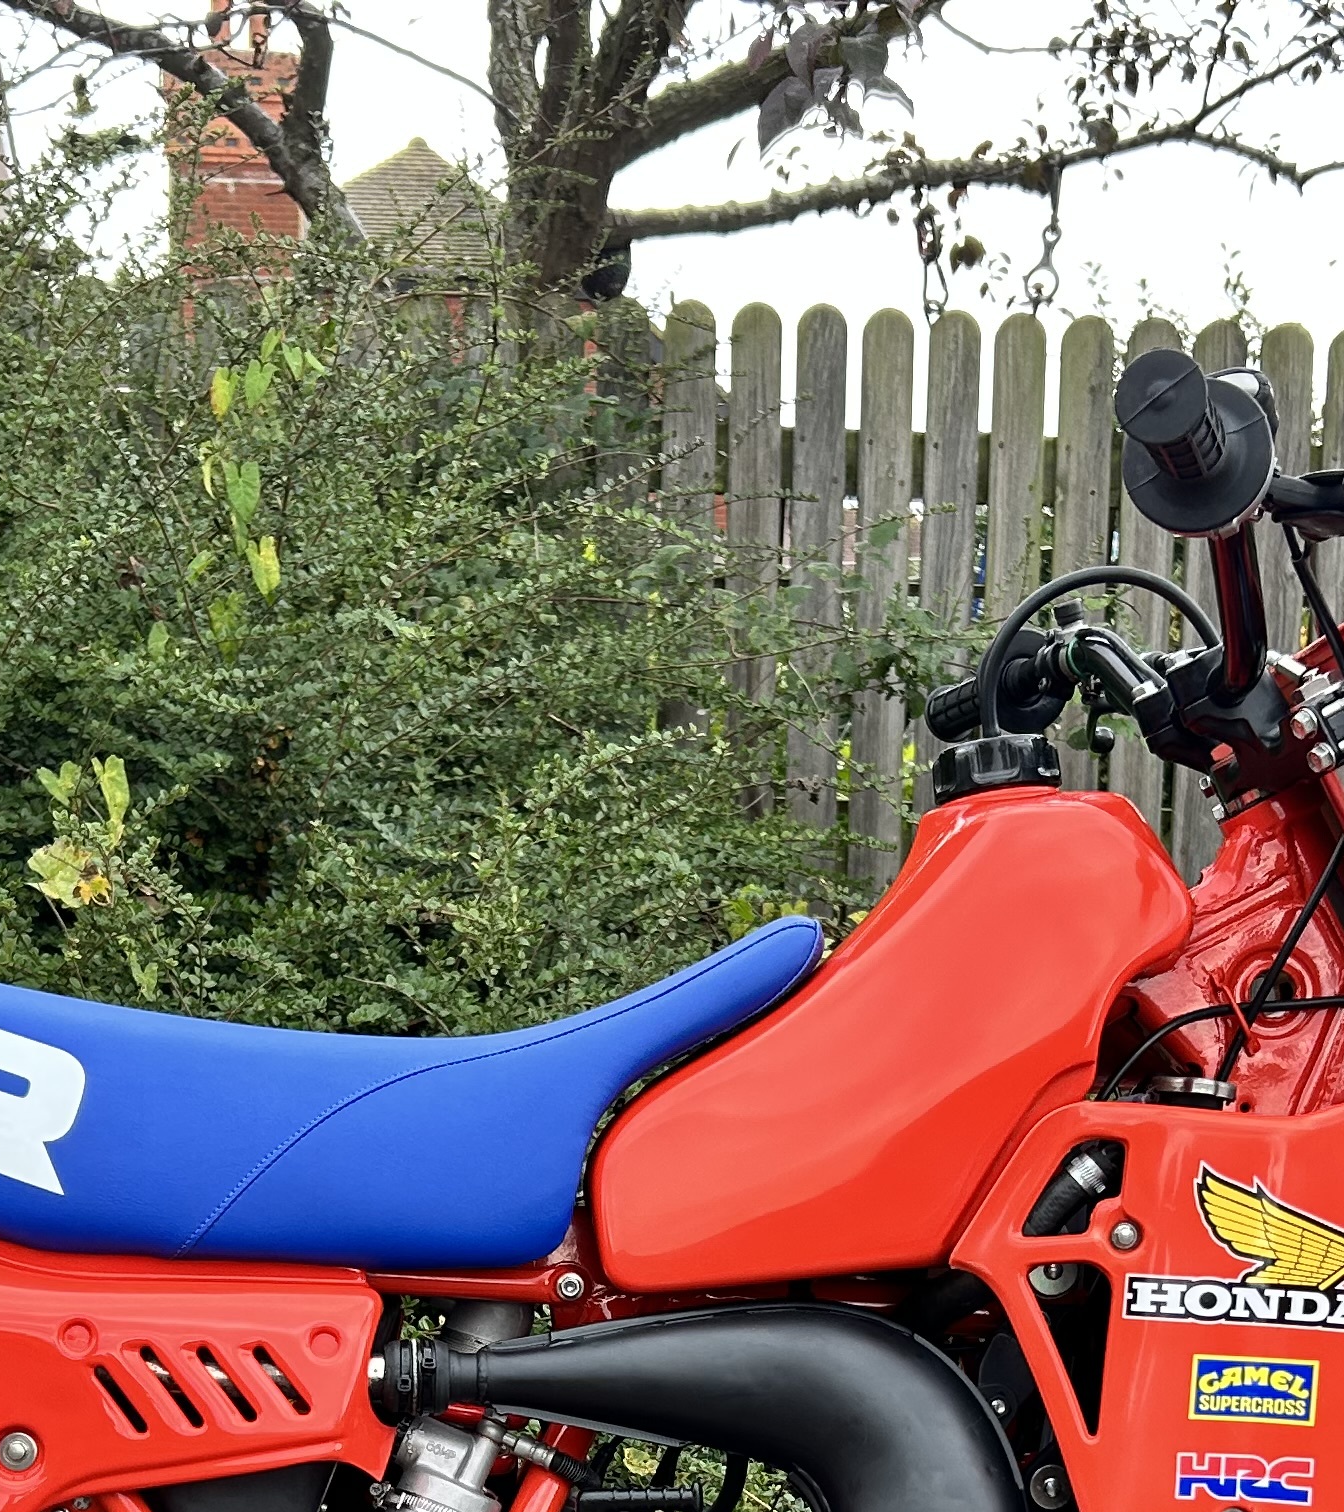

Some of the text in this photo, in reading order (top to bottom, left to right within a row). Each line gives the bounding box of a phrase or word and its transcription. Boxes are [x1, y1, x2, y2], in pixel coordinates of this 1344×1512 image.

[1198, 1366, 1310, 1399] CAMEL
[1198, 1395, 1307, 1416] SUPERCROSS
[1175, 1452, 1315, 1506] HRC
